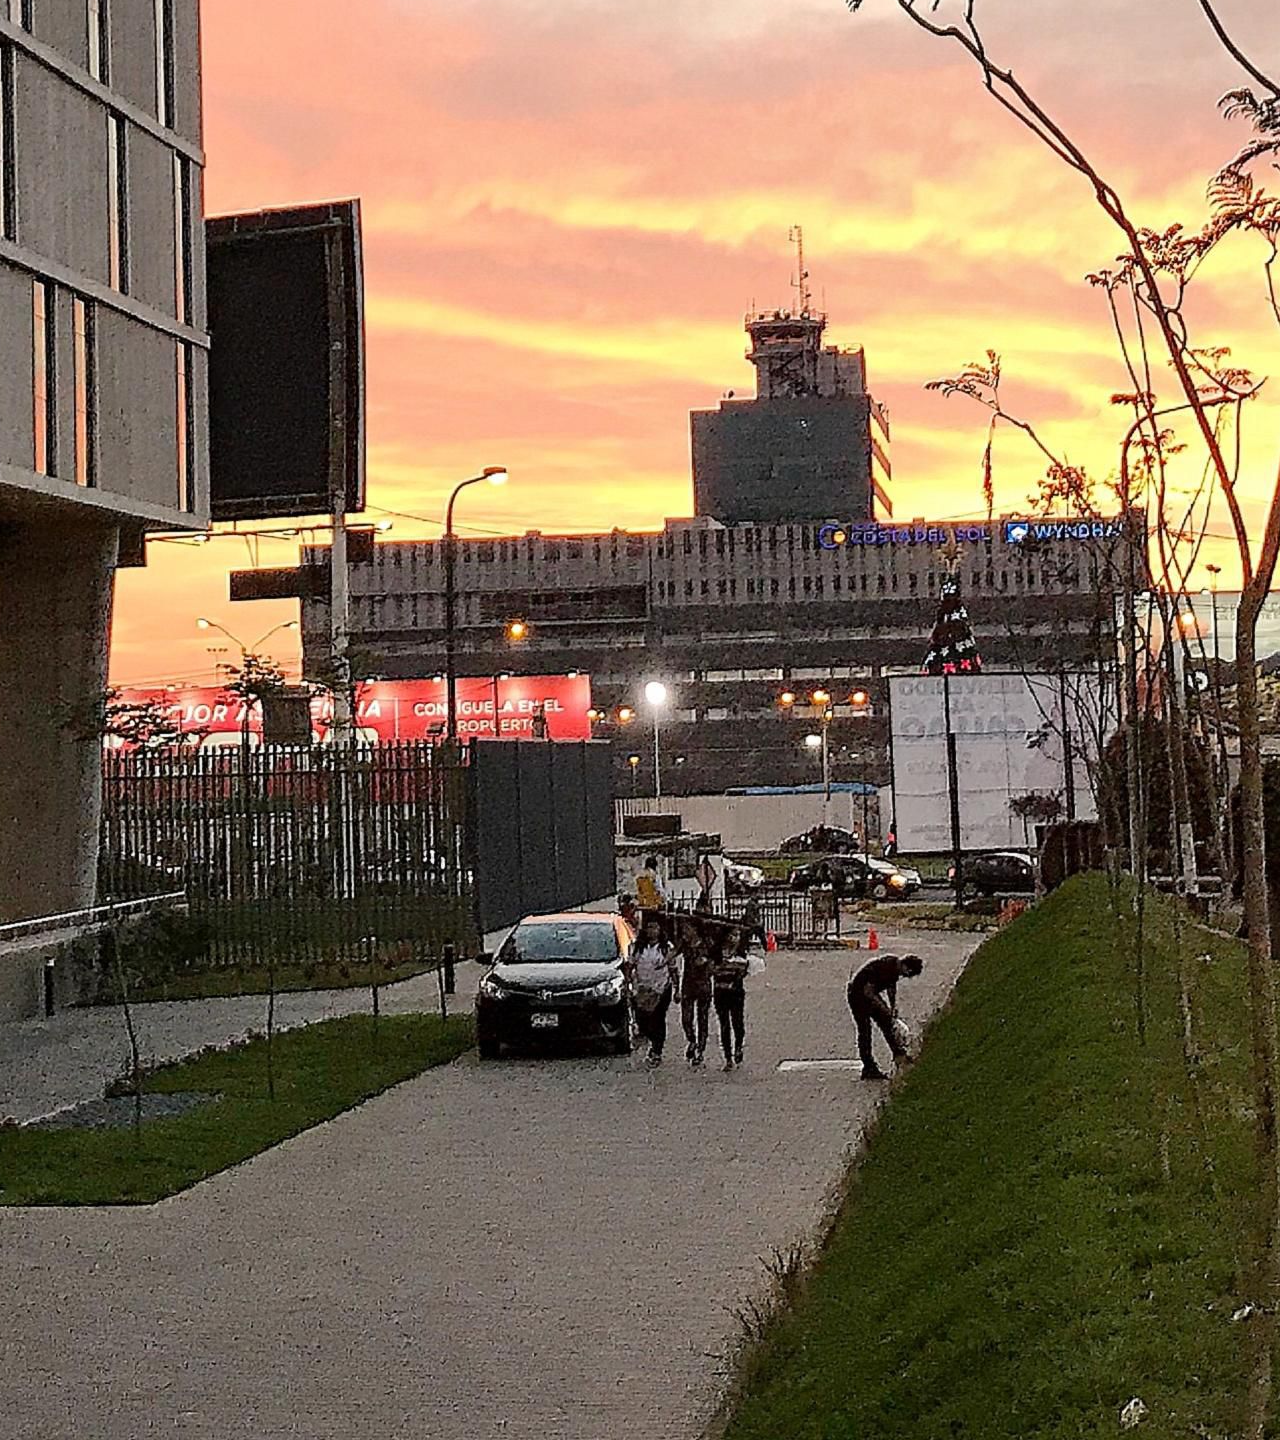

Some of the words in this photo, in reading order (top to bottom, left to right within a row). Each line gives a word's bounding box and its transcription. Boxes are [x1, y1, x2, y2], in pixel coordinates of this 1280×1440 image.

[850, 529, 911, 544] COSTA
[914, 528, 946, 543] DEL
[956, 527, 991, 541] SOL
[1034, 522, 1123, 539] WYNDHA
[544, 698, 564, 712] EL
[442, 718, 535, 733] ROPUERT
